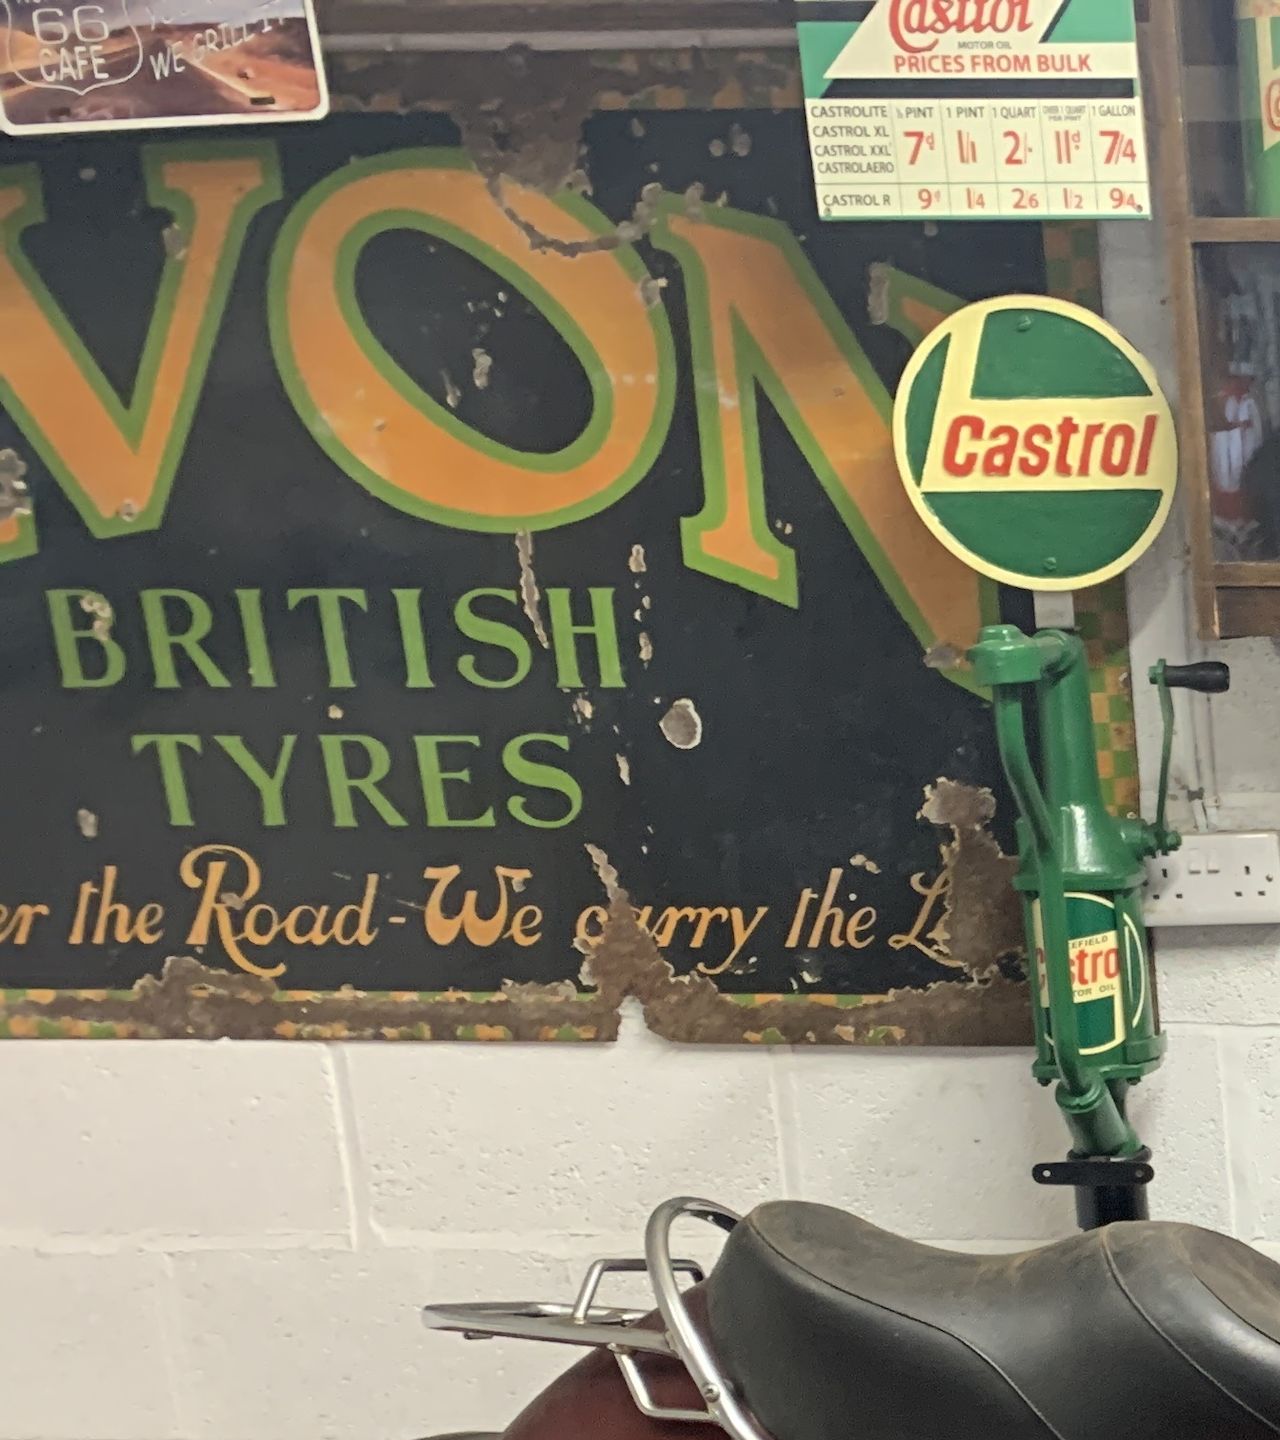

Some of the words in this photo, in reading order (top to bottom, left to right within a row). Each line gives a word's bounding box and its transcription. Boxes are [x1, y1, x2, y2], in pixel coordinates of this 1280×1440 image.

[32, 6, 109, 45] 66
[40, 45, 110, 81] CAFE
[150, 41, 186, 81] WE
[894, 55, 965, 73] PRICES
[970, 55, 1032, 73] FROM
[1037, 54, 1092, 73] BULK
[957, 41, 993, 50] MOTOR
[811, 106, 888, 118] CASTROLITE
[905, 107, 933, 118] PINT
[956, 107, 985, 118] PINT
[1000, 106, 1037, 119] QUART
[1099, 105, 1136, 117] GALLON
[813, 125, 871, 137] CASTROL
[875, 125, 889, 137] XL
[815, 144, 868, 157] CASTROL
[823, 193, 880, 206] CASTROL
[883, 193, 891, 206] R
[0, 138, 1000, 704] VON
[941, 414, 1158, 478] Castrol
[44, 587, 627, 690] BRITISH
[131, 732, 584, 829] TYRES
[67, 864, 165, 945] the
[179, 843, 380, 978] Road
[422, 864, 544, 946] We
[783, 867, 876, 949] the
